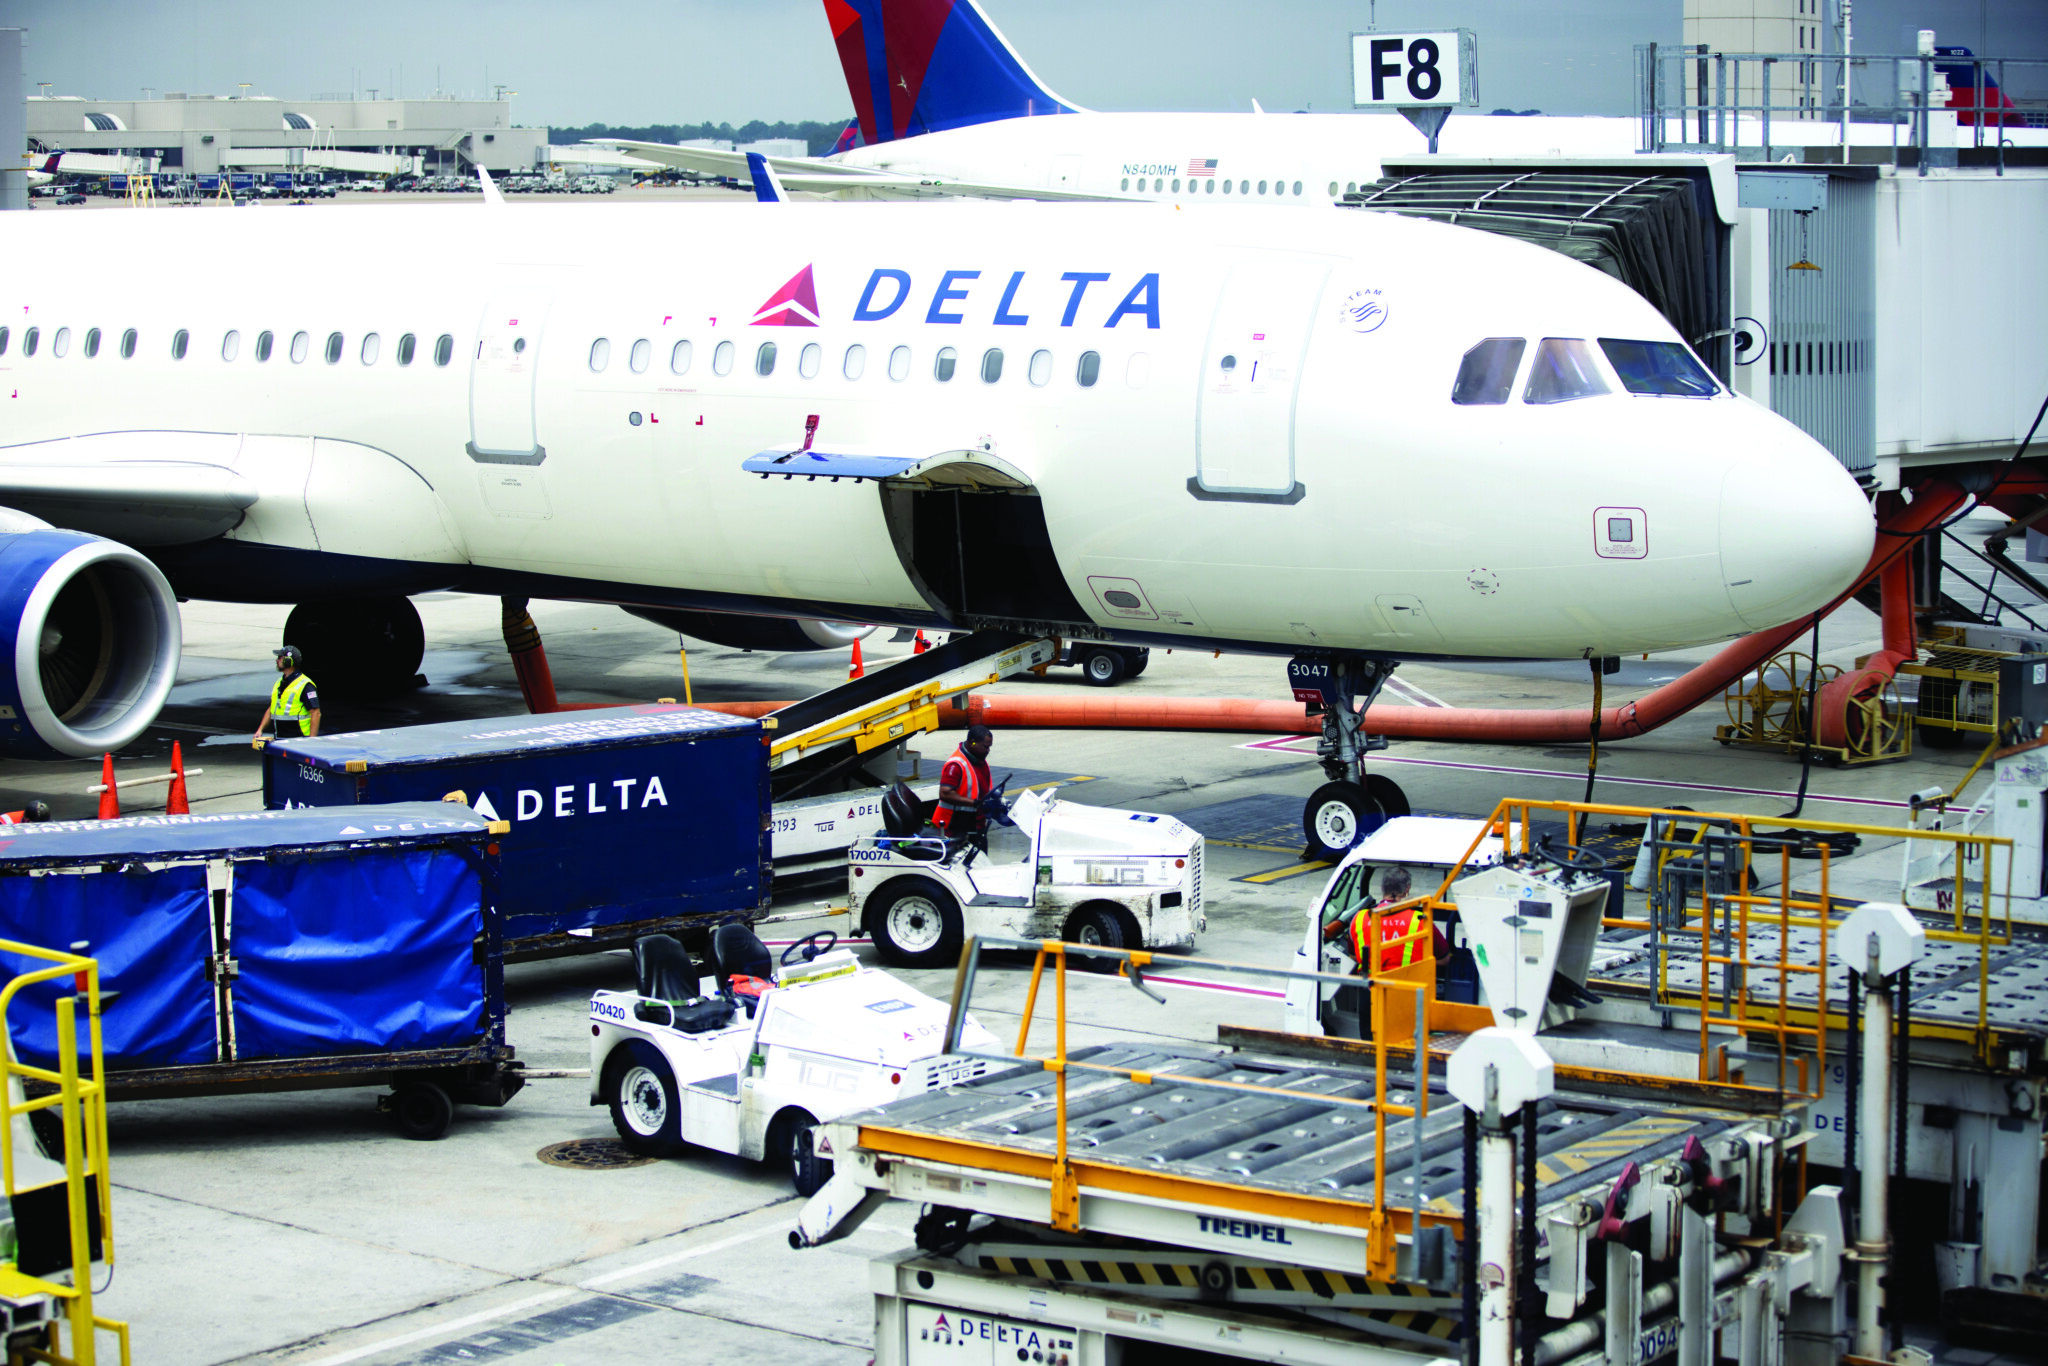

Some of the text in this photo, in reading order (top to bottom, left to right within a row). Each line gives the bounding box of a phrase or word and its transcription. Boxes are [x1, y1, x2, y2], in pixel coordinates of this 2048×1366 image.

[1370, 38, 1442, 101] F8
[1121, 163, 1178, 176] N840MH
[852, 268, 1161, 330] DELTA
[1291, 663, 1328, 677] 3047
[298, 763, 324, 784] 76366
[517, 776, 668, 821] DELTA
[859, 804, 880, 816] DEL
[373, 821, 481, 832] DELTA
[814, 820, 835, 832] TUG
[849, 850, 891, 860] 170074
[1073, 859, 1149, 883] TUG
[590, 1000, 625, 1020] 170420
[787, 1051, 864, 1094] TUG
[942, 1065, 971, 1081] TUG
[1196, 1214, 1293, 1246] TREPEL
[960, 1318, 1041, 1349] DELTA
